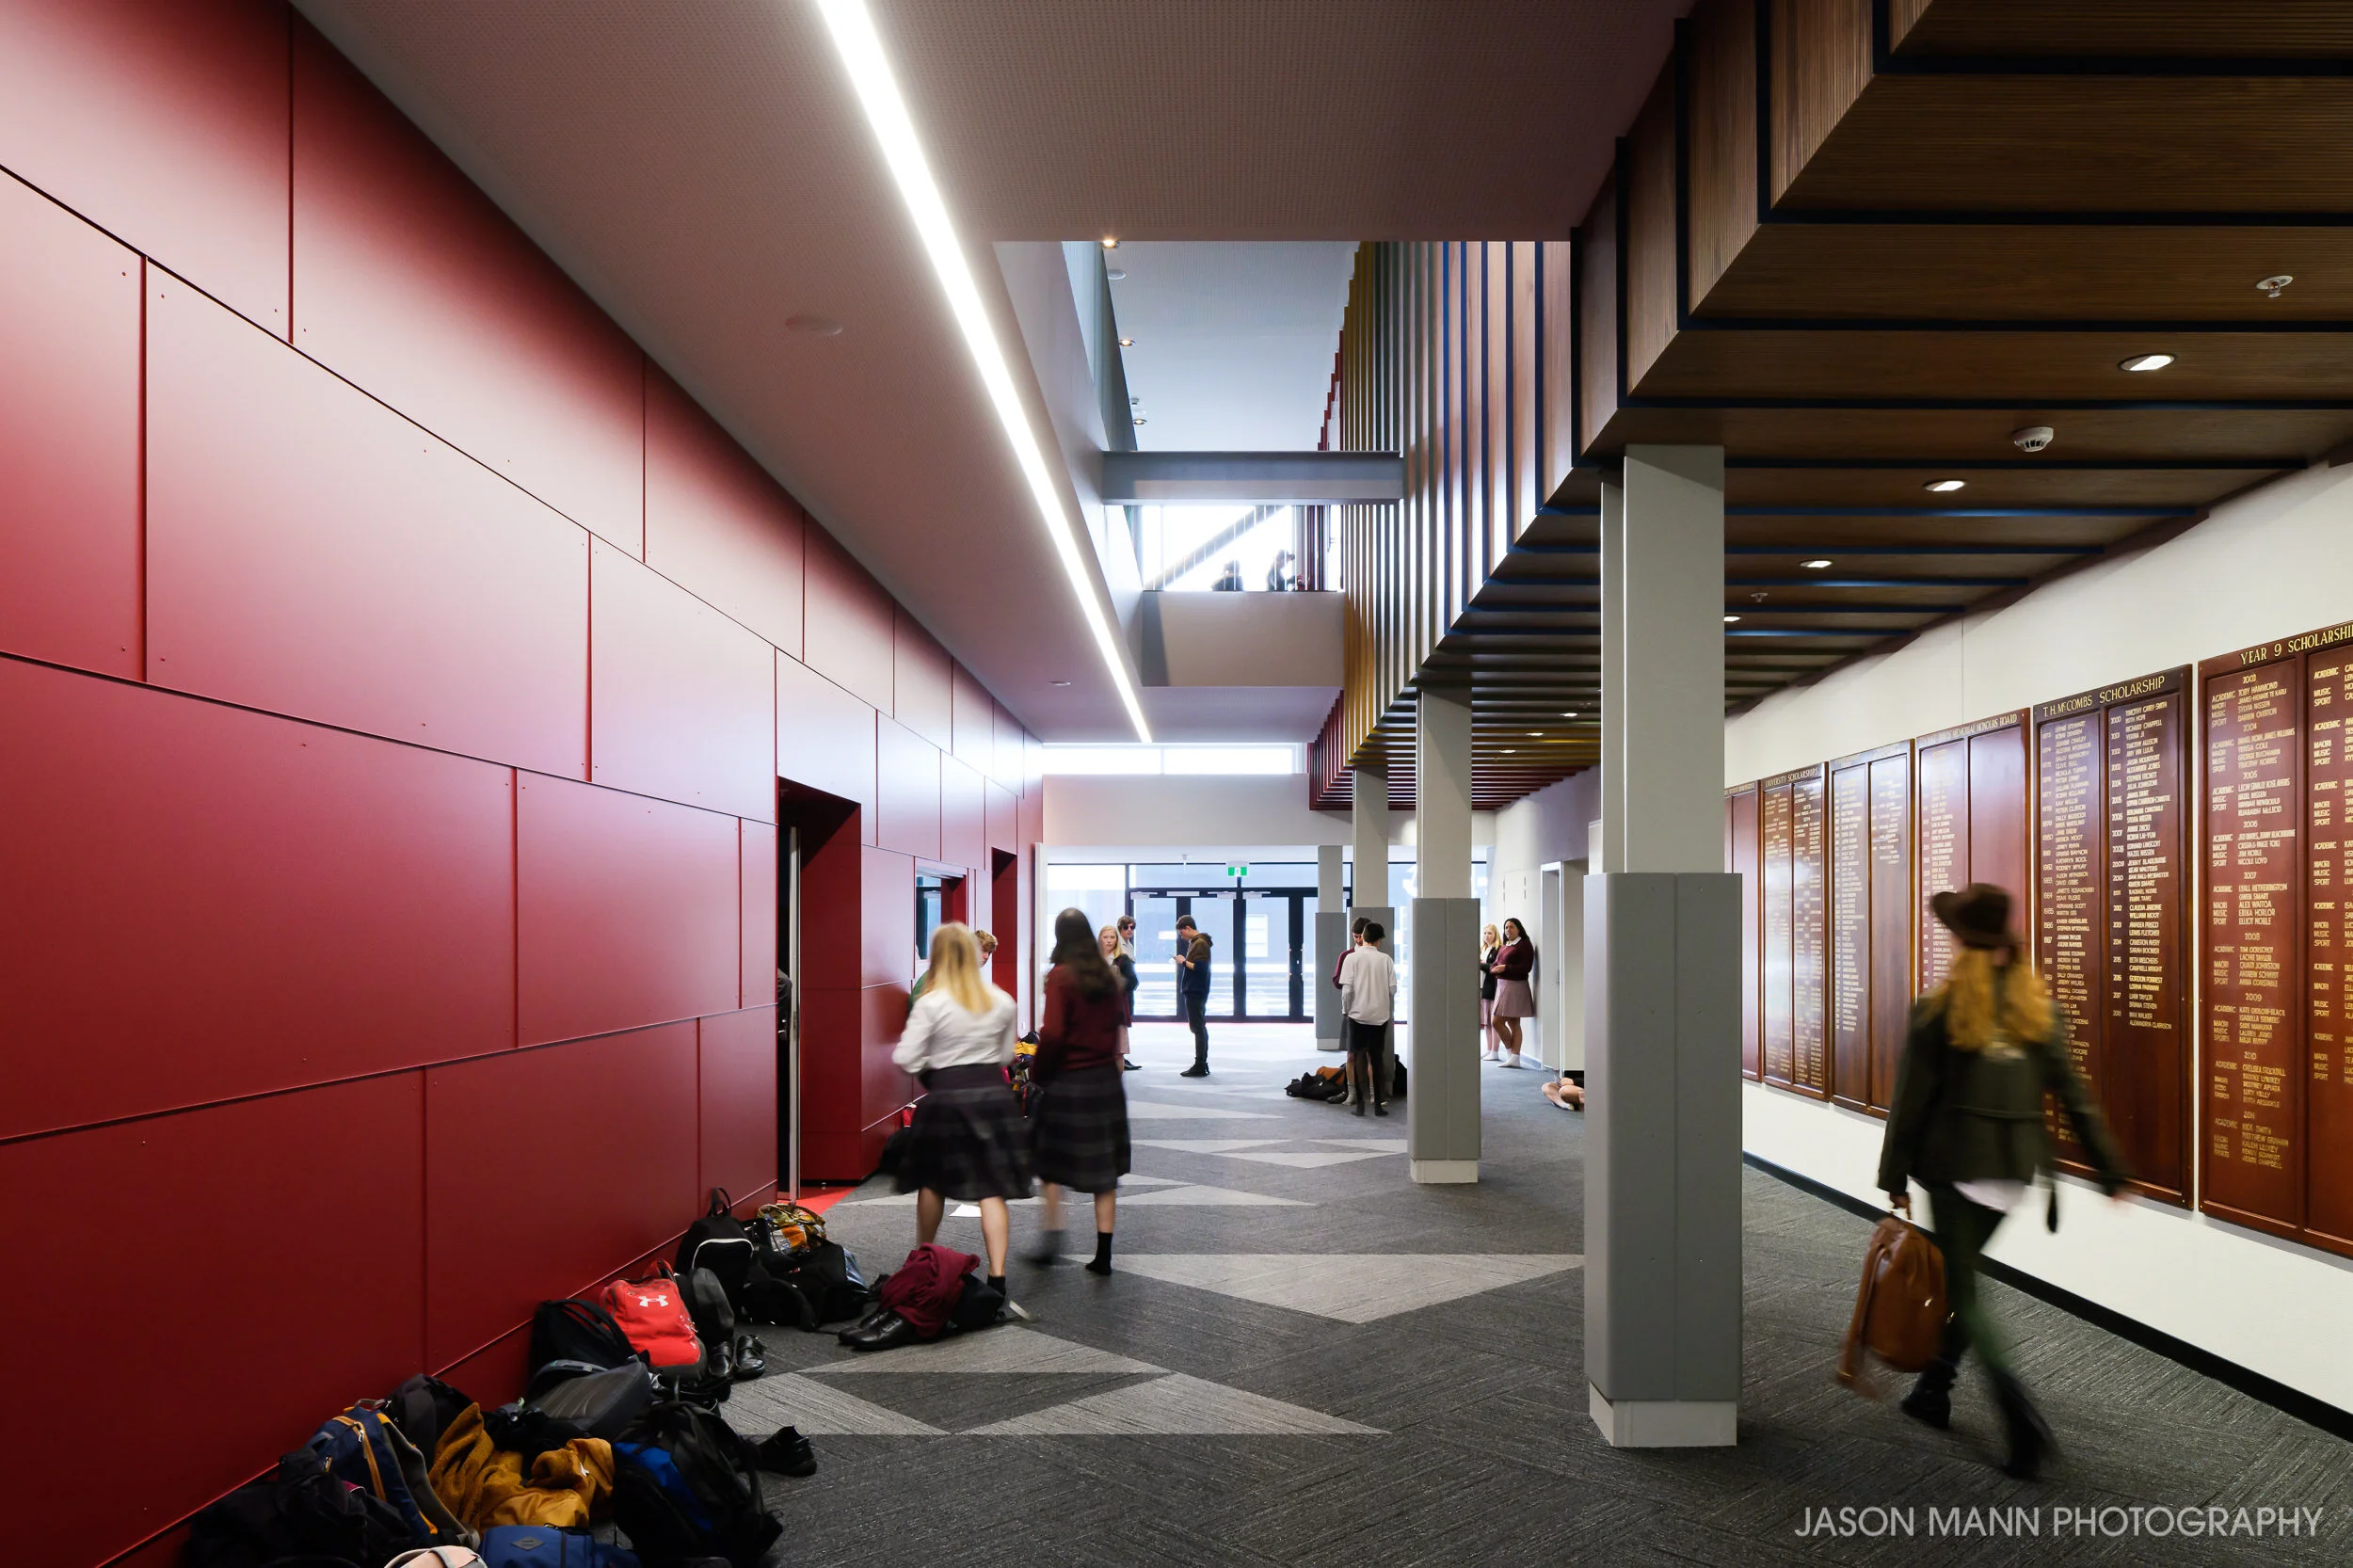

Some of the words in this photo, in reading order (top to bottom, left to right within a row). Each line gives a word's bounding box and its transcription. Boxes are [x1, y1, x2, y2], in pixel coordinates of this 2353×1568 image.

[2240, 648, 2267, 664] YEAR
[2274, 644, 2281, 657] 9
[2313, 667, 2339, 680] ACADEMIC
[2099, 676, 2165, 704] SCHOLARSHIP
[2313, 687, 2330, 696] MUSIC
[2313, 696, 2331, 706] SPORT
[1977, 719, 1997, 730] HONOURS
[1999, 713, 2017, 725] BOARD
[2313, 720, 2340, 731] ACADEMIC
[2313, 758, 2330, 766] SPORT
[1787, 768, 1818, 782] SCHOLARSHIPS
[2313, 818, 2330, 826] SPORT
[2245, 933, 2260, 941] 2008
